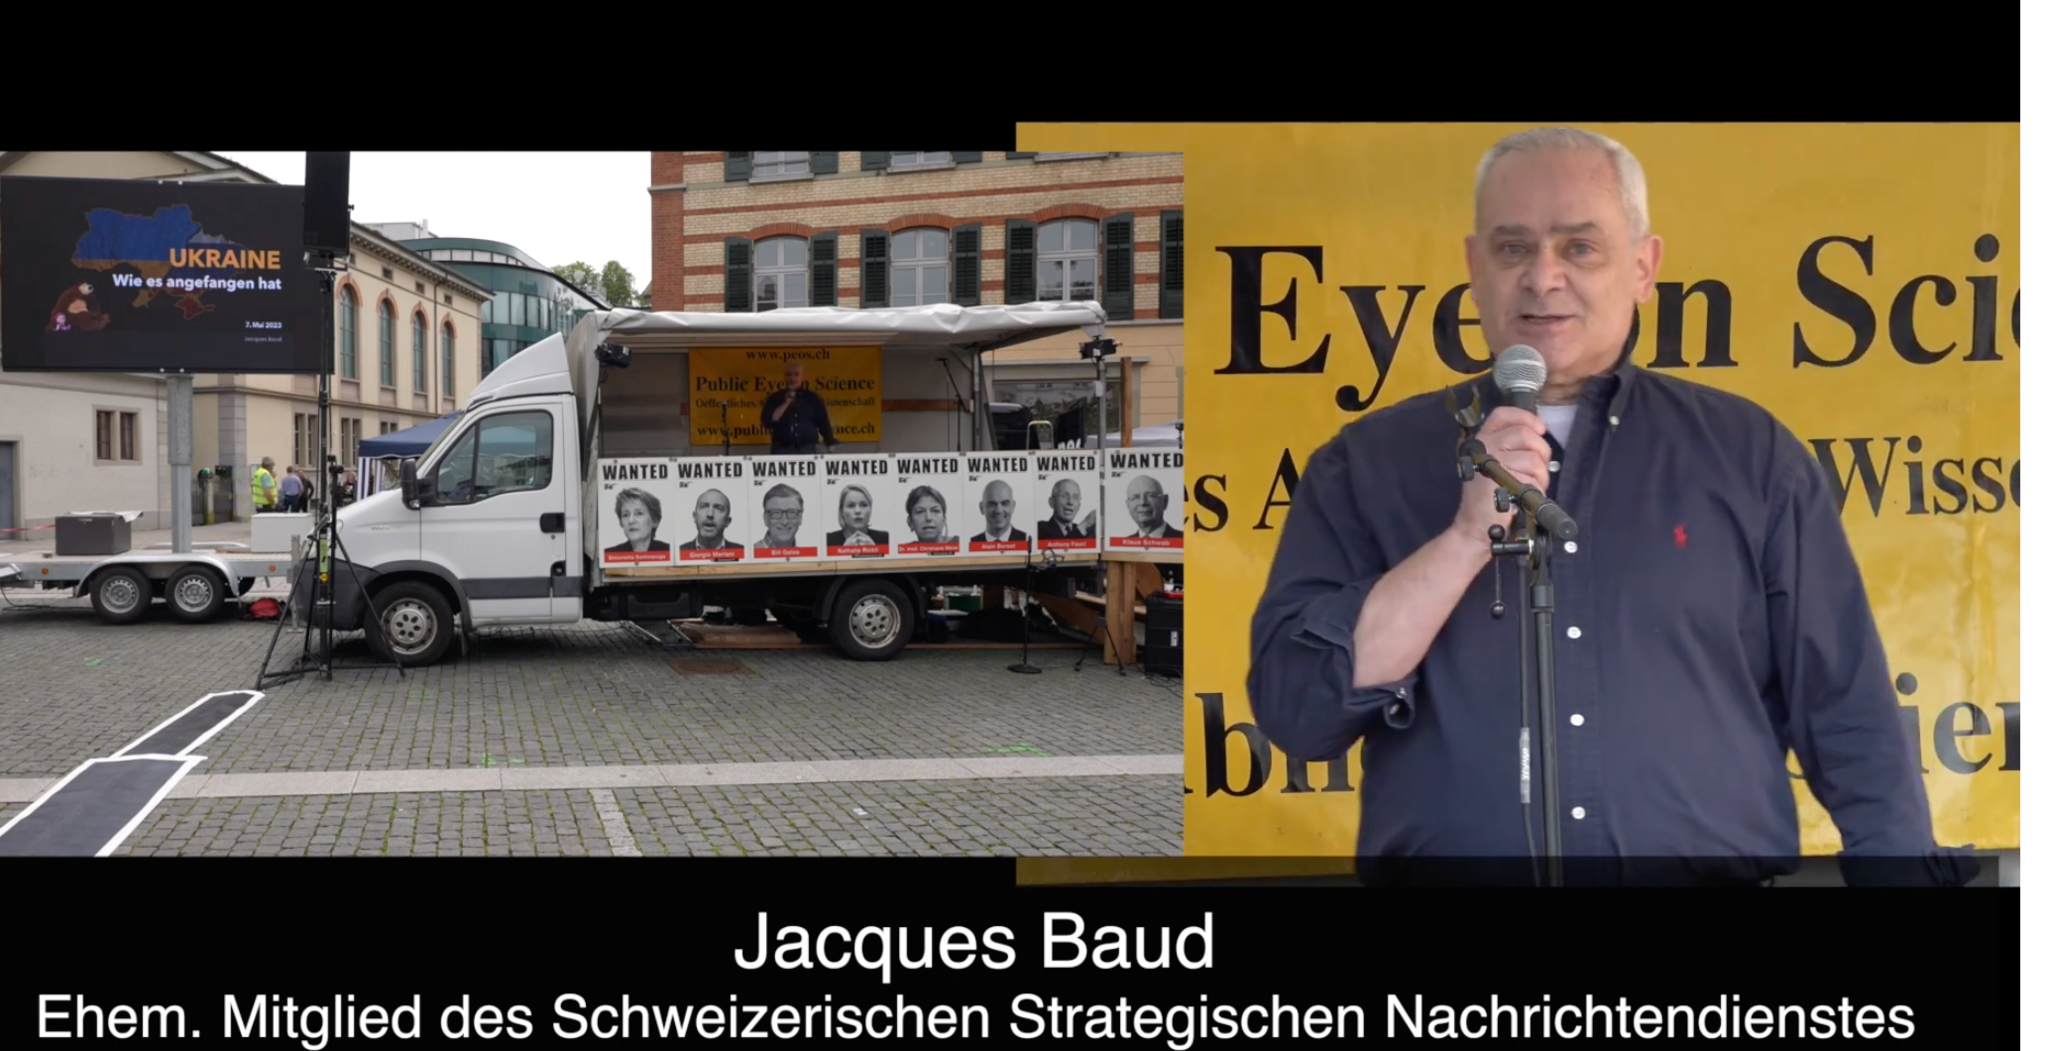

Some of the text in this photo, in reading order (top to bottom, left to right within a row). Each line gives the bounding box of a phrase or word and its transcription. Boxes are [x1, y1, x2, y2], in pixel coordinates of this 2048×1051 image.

[169, 248, 281, 270] UKRAINE
[112, 273, 282, 292] Wie es angefangen hat
[252, 321, 264, 329] Mai
[265, 321, 282, 329] 2023
[1214, 246, 1497, 412] Eye
[1793, 233, 2020, 368] Sci
[746, 348, 830, 362] www.peos.ch
[696, 376, 748, 392] Public
[754, 376, 787, 394] Eye
[814, 376, 875, 391] Science
[825, 397, 875, 407] issenschaft
[825, 459, 888, 476] WANTED
[897, 458, 958, 474] WANTED
[967, 457, 1028, 473] WANTED
[1036, 455, 1096, 471] WANTED
[1110, 452, 1184, 469] WANTED
[602, 464, 668, 480] WANTED
[677, 462, 743, 479] WANTED
[752, 461, 816, 478] WANTED
[1808, 435, 2020, 518] Wiss
